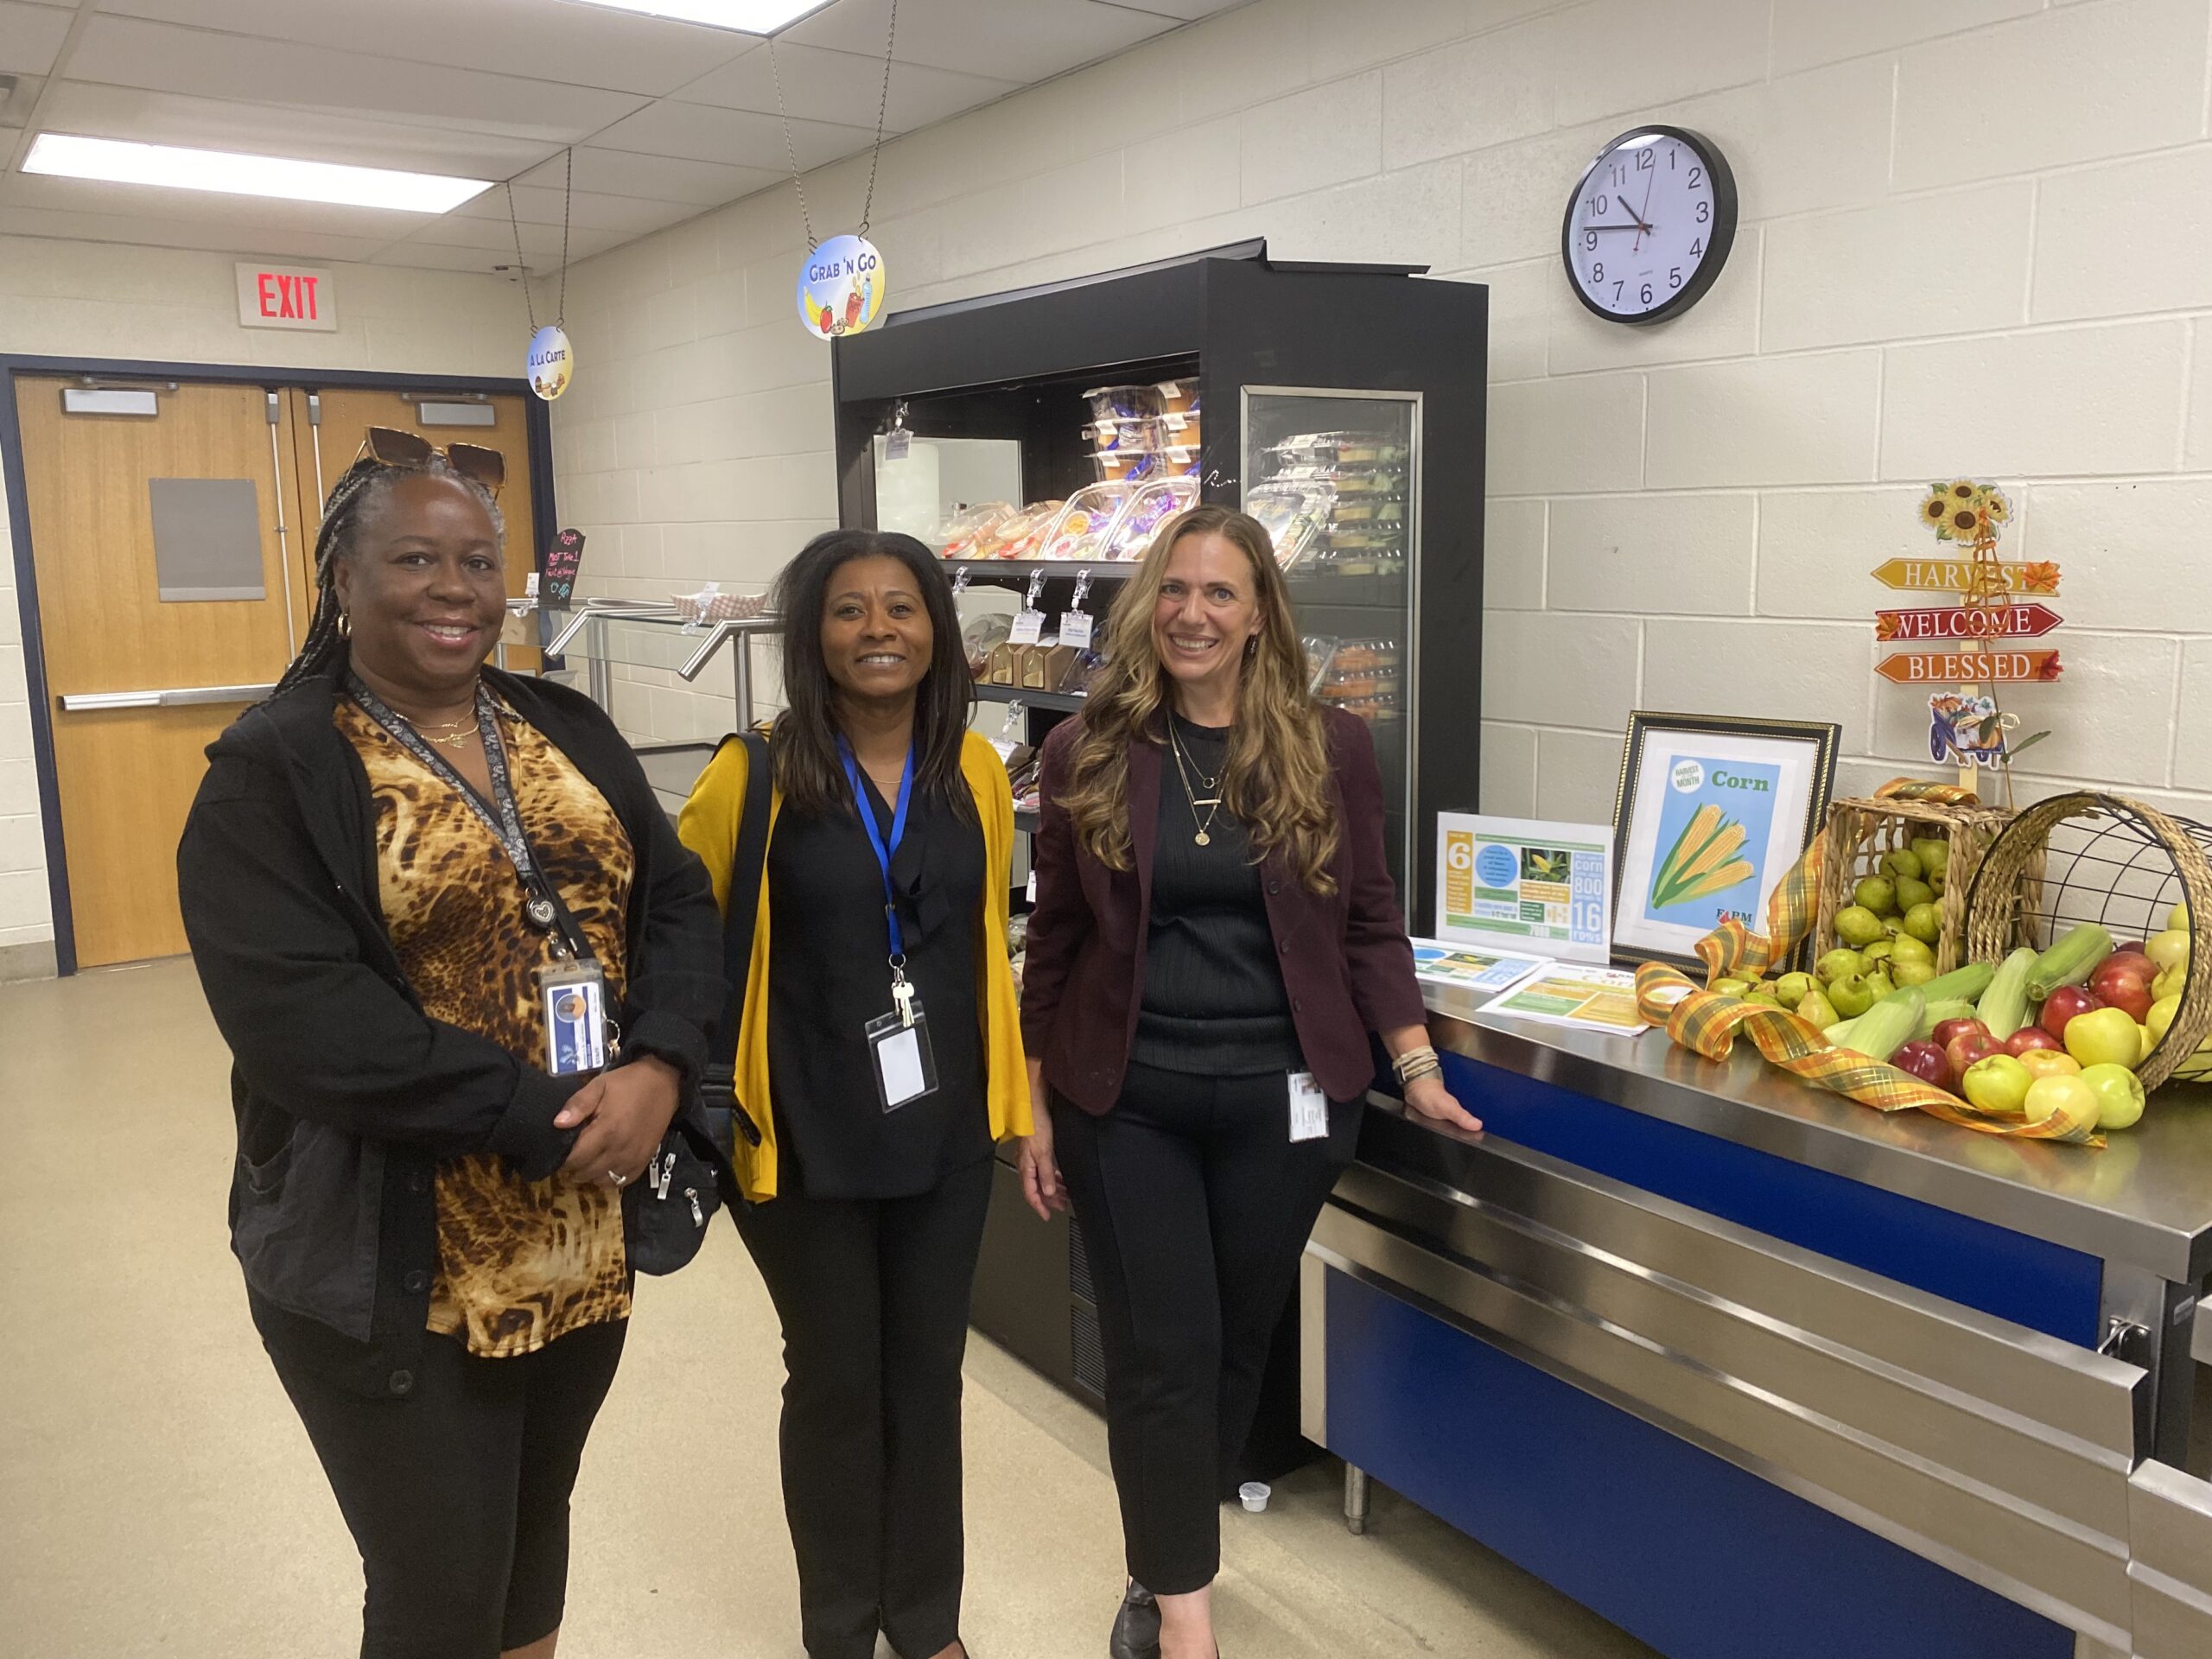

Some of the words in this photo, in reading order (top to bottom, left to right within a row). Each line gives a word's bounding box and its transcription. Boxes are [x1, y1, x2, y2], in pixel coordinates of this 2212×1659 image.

[1634, 148, 1654, 171] 12
[1669, 149, 1675, 170] 1
[1611, 165, 1626, 188] 11
[1688, 167, 1701, 189] 2
[1590, 194, 1608, 217] 10
[1695, 201, 1709, 223] 3
[1586, 231, 1598, 251] 9
[1689, 238, 1702, 258] 4
[809, 263, 840, 283] GRAB
[1592, 263, 1605, 283] 8
[1669, 267, 1681, 289] 5
[257, 273, 319, 320] EXIT
[1612, 280, 1624, 302] 7
[1640, 283, 1653, 304] 6
[530, 355, 535, 366] A
[1898, 608, 2031, 638] WELCOME
[1908, 653, 2031, 680] BLESSED
[1712, 770, 1769, 791] Corn
[1448, 842, 1471, 870] 6
[1574, 860, 1603, 873] corn
[1574, 876, 1603, 896] 800
[1573, 901, 1602, 932] 16
